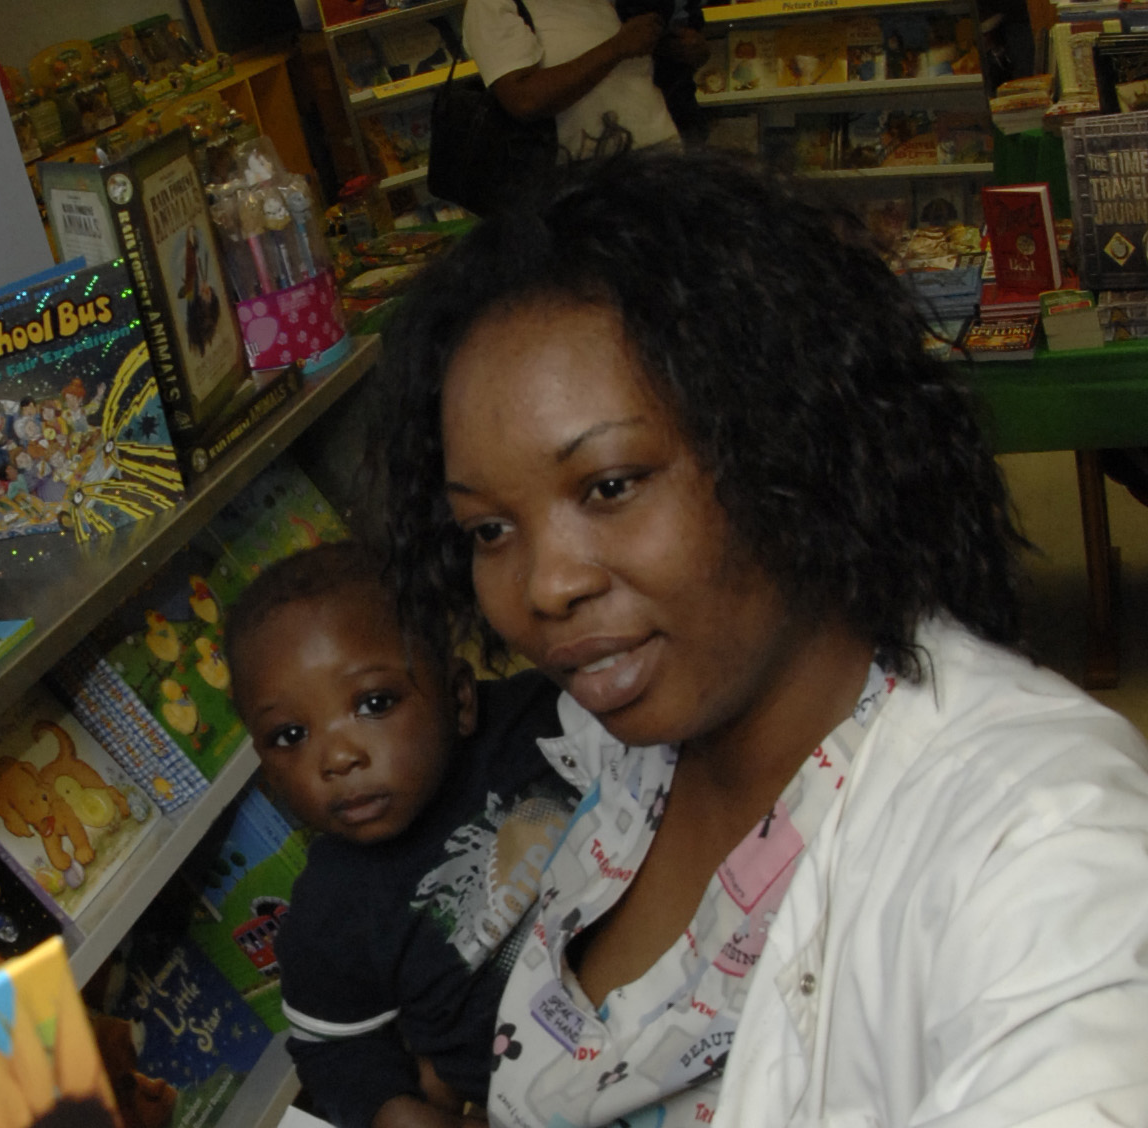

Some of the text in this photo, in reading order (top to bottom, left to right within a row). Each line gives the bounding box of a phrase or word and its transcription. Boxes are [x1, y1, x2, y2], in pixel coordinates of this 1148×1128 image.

[57, 296, 114, 338] Bus
[969, 327, 1032, 337] SPELLING
[6, 356, 39, 377] Fair
[153, 976, 201, 1037] Little
[188, 1006, 222, 1053] Star
